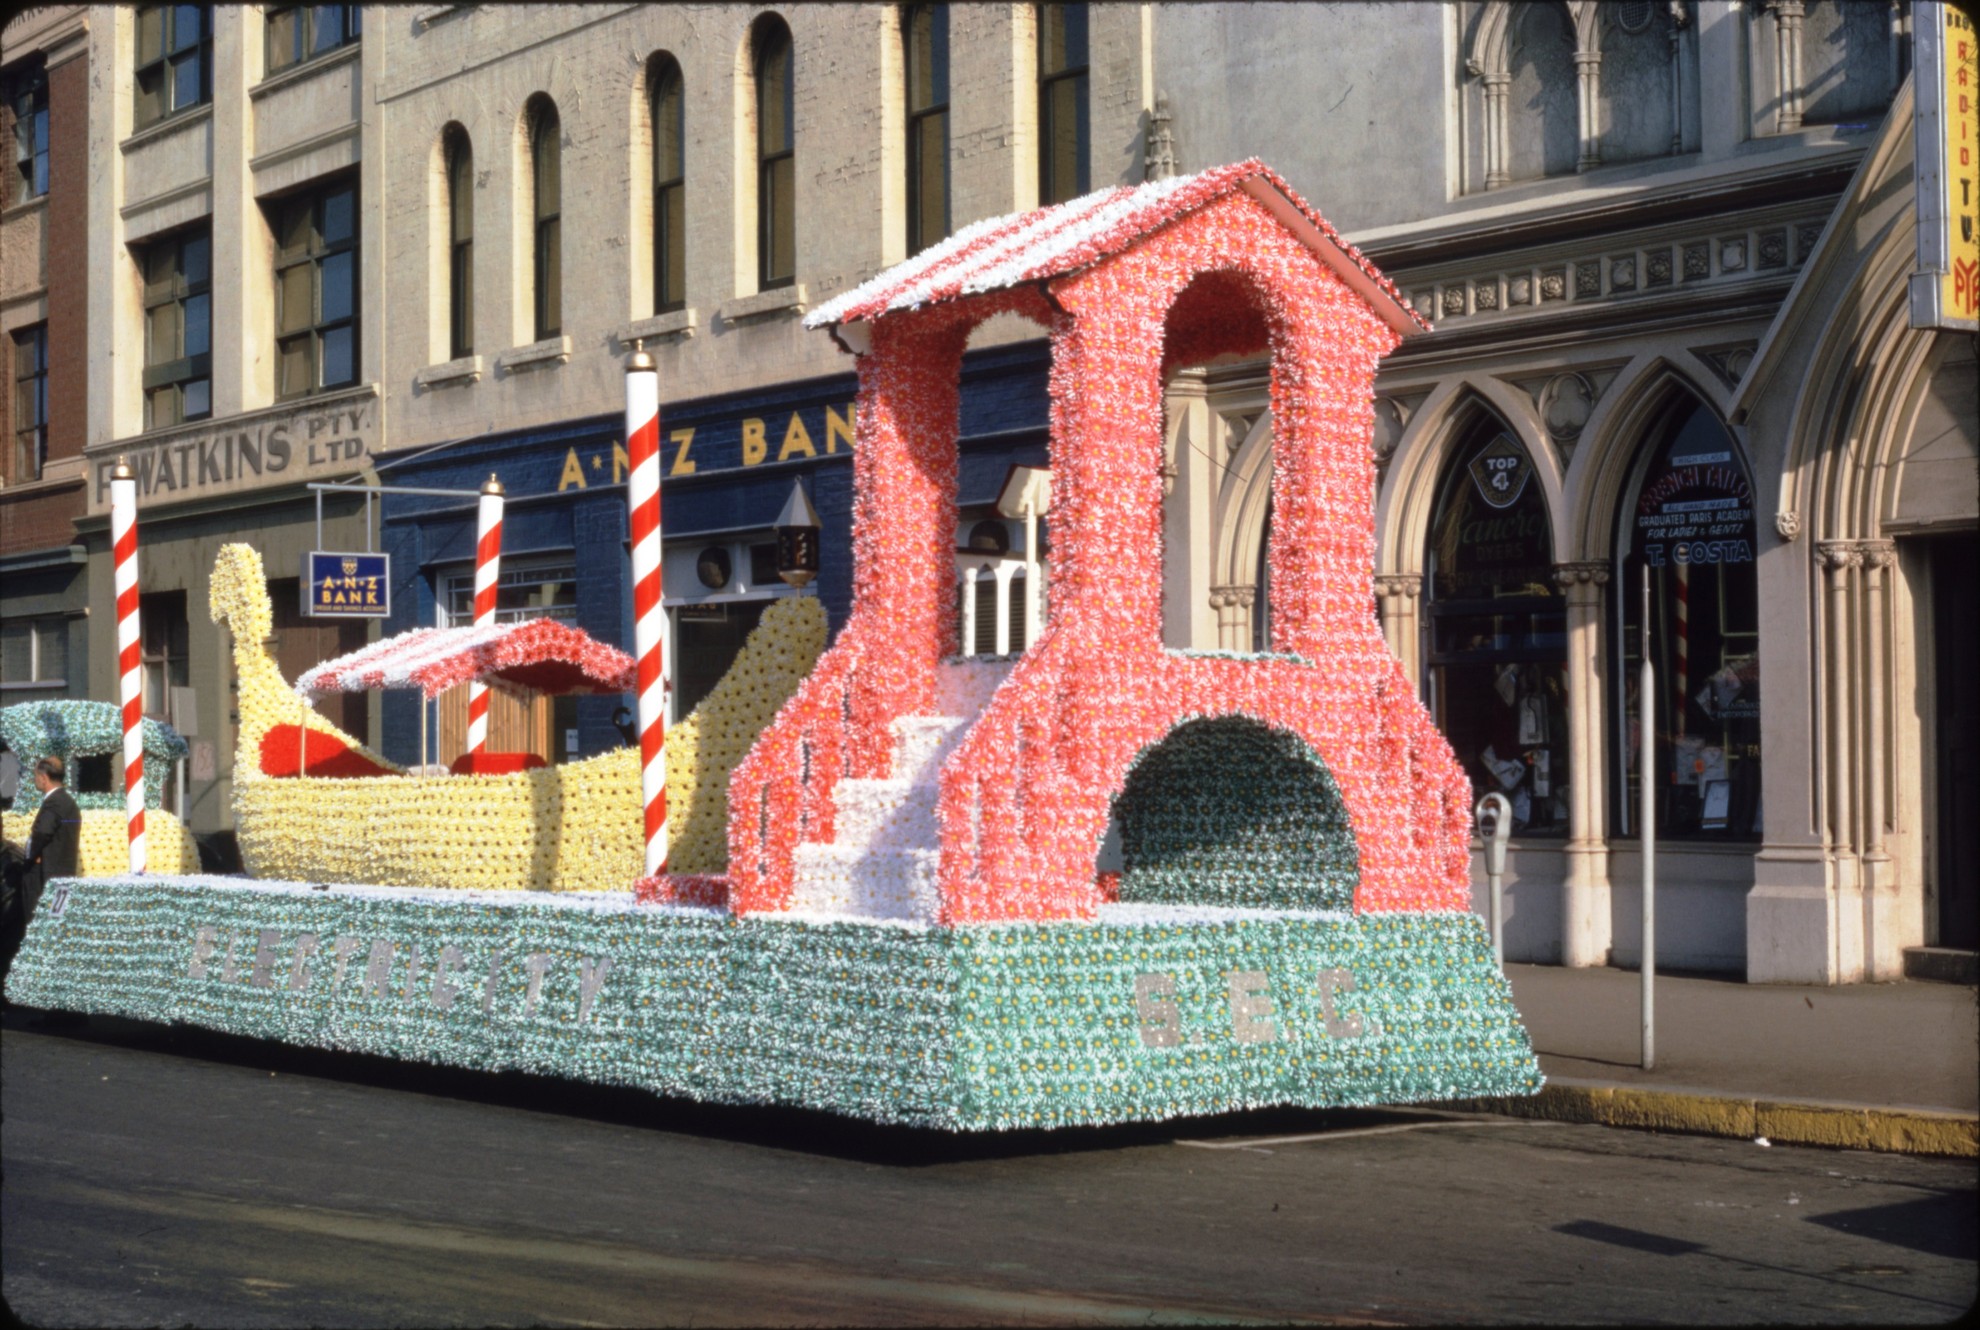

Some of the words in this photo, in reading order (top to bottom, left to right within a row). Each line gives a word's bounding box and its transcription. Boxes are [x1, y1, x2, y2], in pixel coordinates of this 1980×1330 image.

[1946, 12, 1974, 31] BRO
[1958, 41, 1971, 167] RADIO
[308, 408, 371, 439] PTY.
[742, 402, 857, 467] BAN
[131, 425, 292, 496] WATKINS
[308, 437, 371, 466] LTD.
[1487, 457, 1517, 470] TOP
[1492, 472, 1509, 490] 4
[1639, 466, 1699, 514] FRENCH
[1703, 464, 1753, 504] TAILO
[1639, 513, 1685, 527] GRADUATED
[1689, 511, 1713, 524] PARIS
[1716, 509, 1753, 523] ACADEM
[1647, 528, 1666, 539] FOR
[1668, 526, 1698, 538] LADIES
[1672, 539, 1753, 566] COSTA
[322, 591, 377, 604] BANK
[188, 925, 613, 1023] ELECTRICITY
